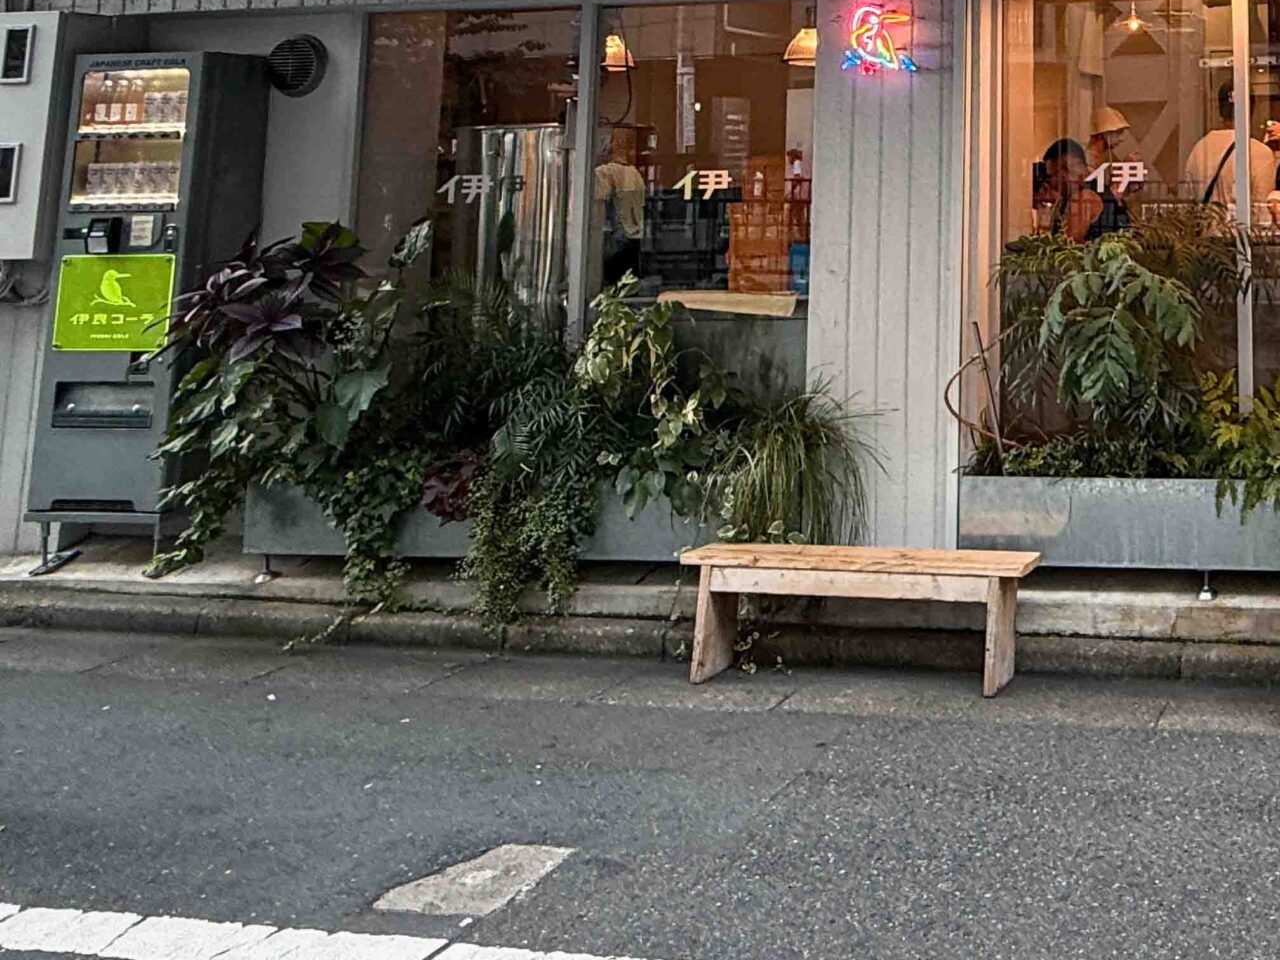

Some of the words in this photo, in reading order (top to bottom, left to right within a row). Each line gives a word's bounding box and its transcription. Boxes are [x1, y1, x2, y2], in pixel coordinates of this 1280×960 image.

[436, 174, 494, 204] 伊
[673, 170, 732, 200] 伊
[1084, 161, 1149, 192] 伊
